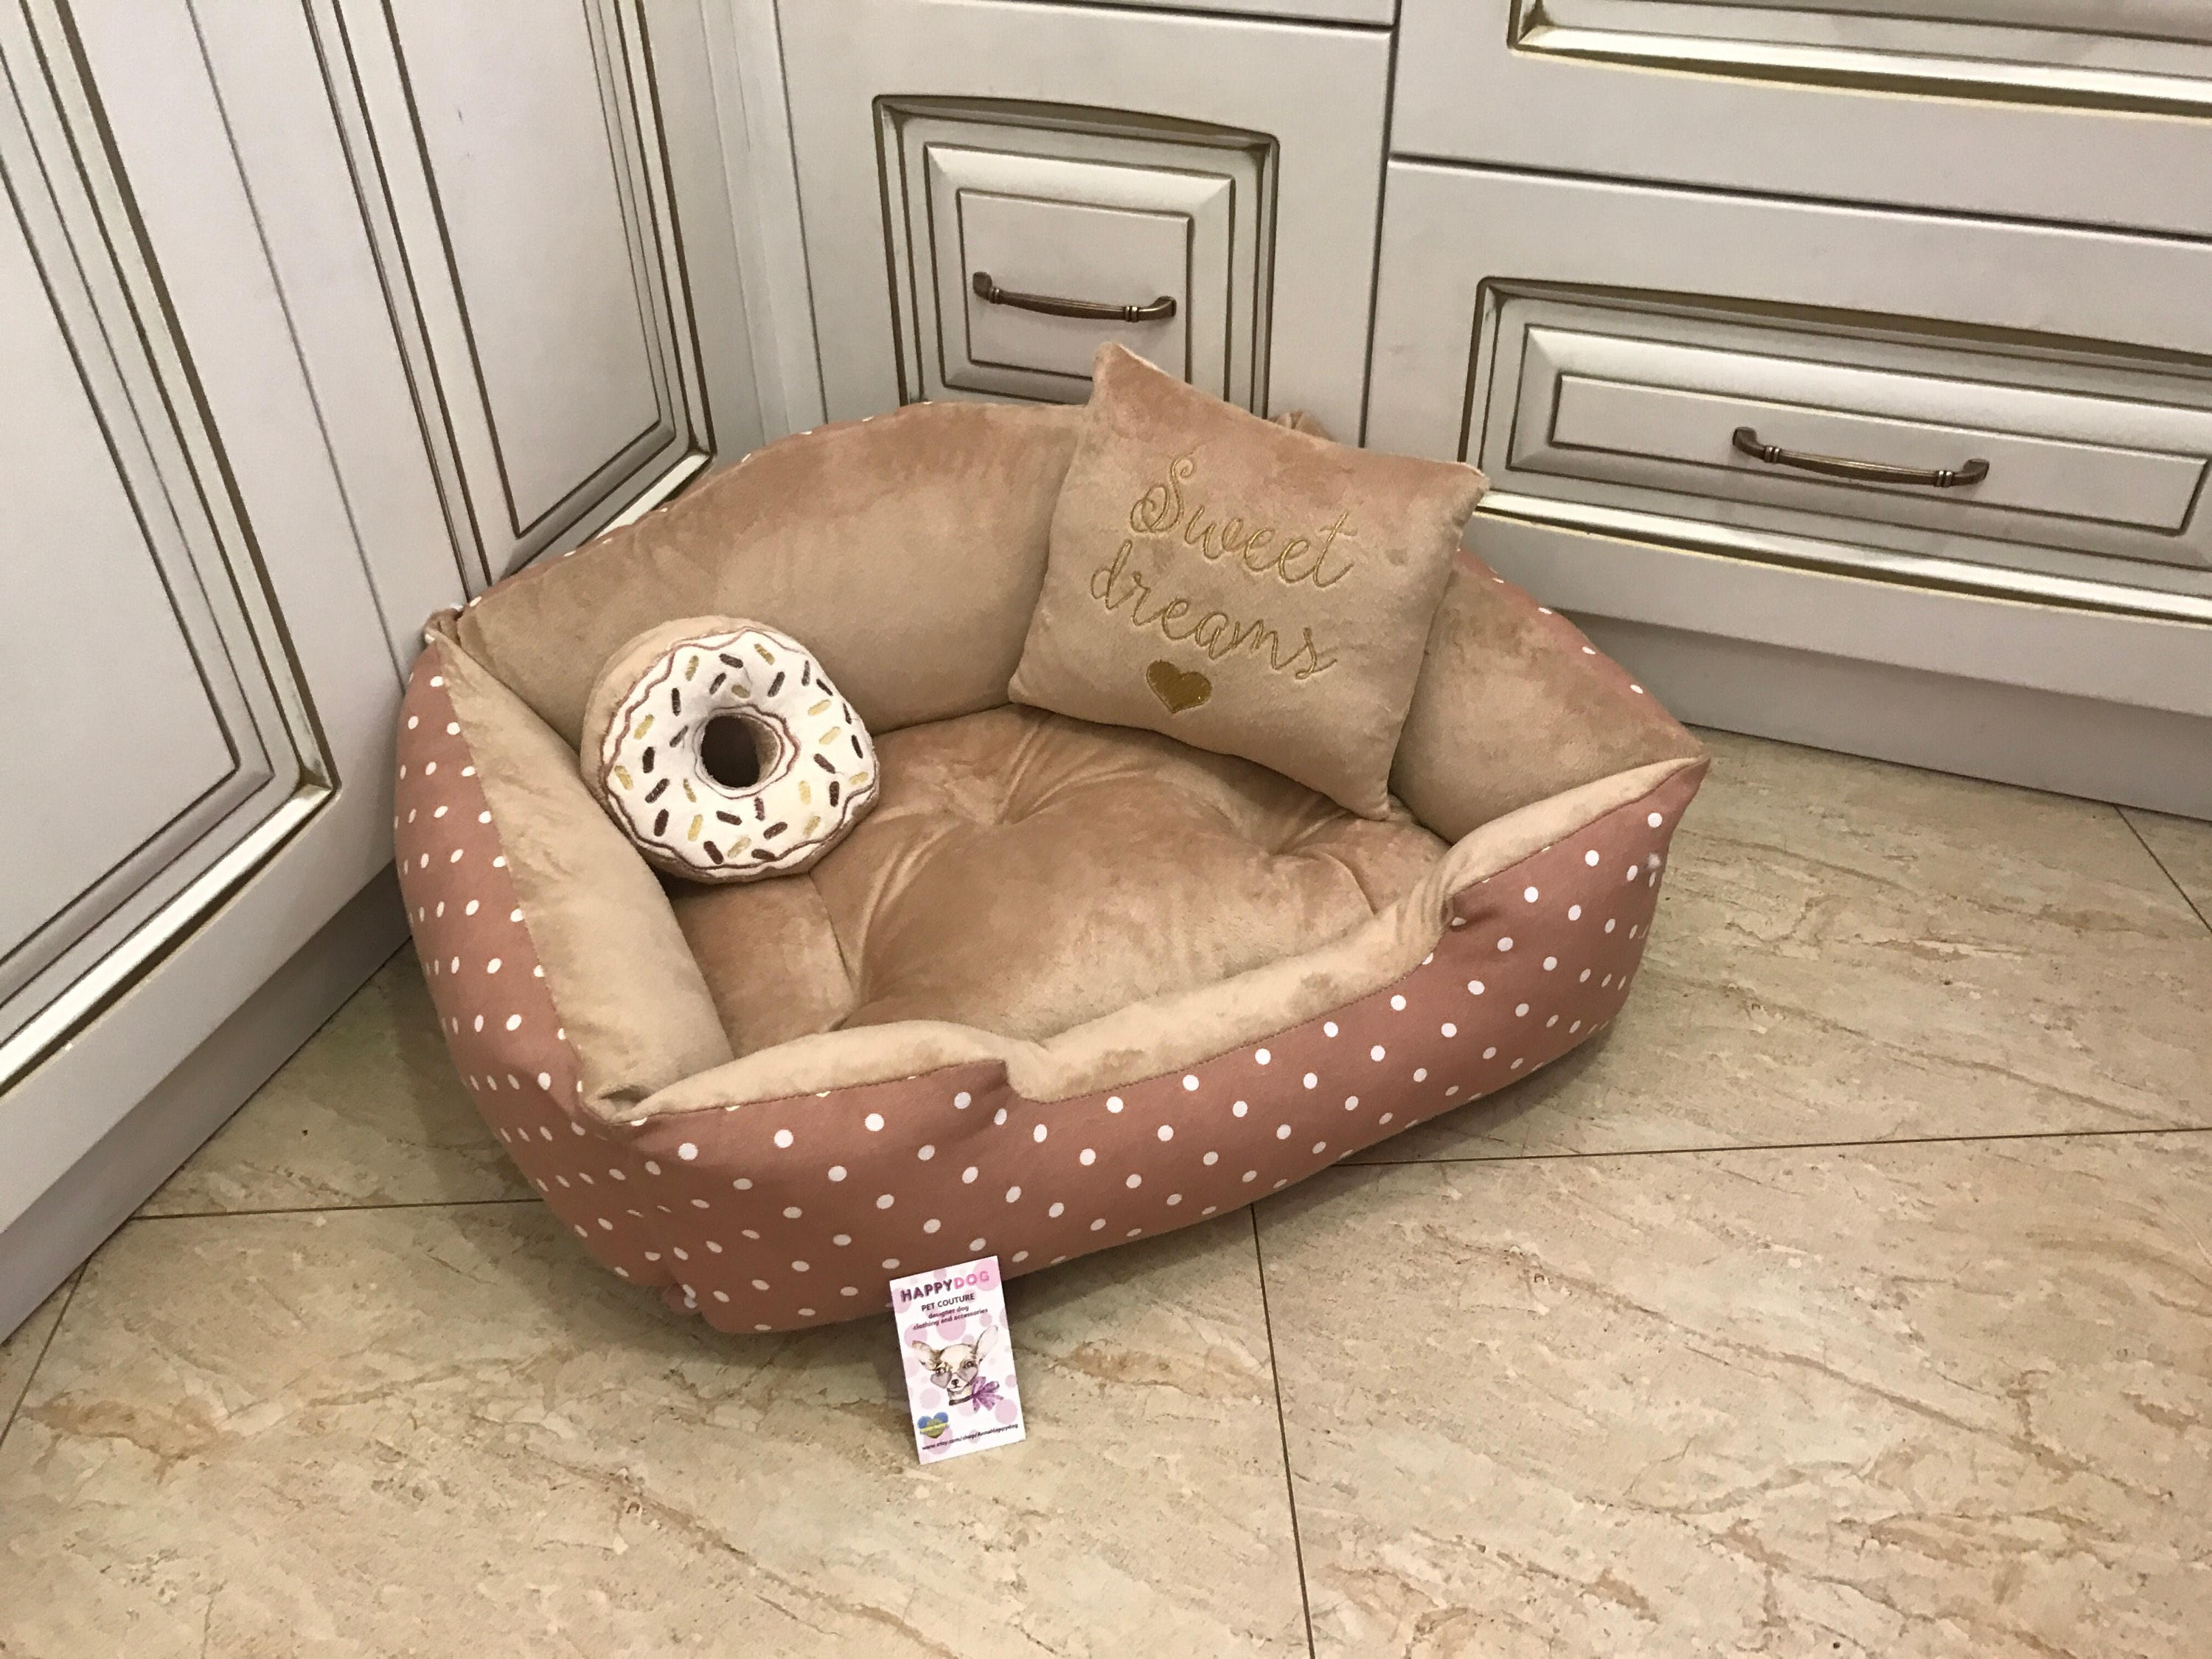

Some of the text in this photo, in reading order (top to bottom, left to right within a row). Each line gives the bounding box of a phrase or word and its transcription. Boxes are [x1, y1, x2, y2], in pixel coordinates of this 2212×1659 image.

[1130, 455, 1357, 588] Sweet
[1090, 539, 1338, 680] dreams
[921, 1293, 975, 1312] PET COUTURE
[928, 1305, 969, 1319] designer dog
[914, 1308, 988, 1330] clothing and accessories
